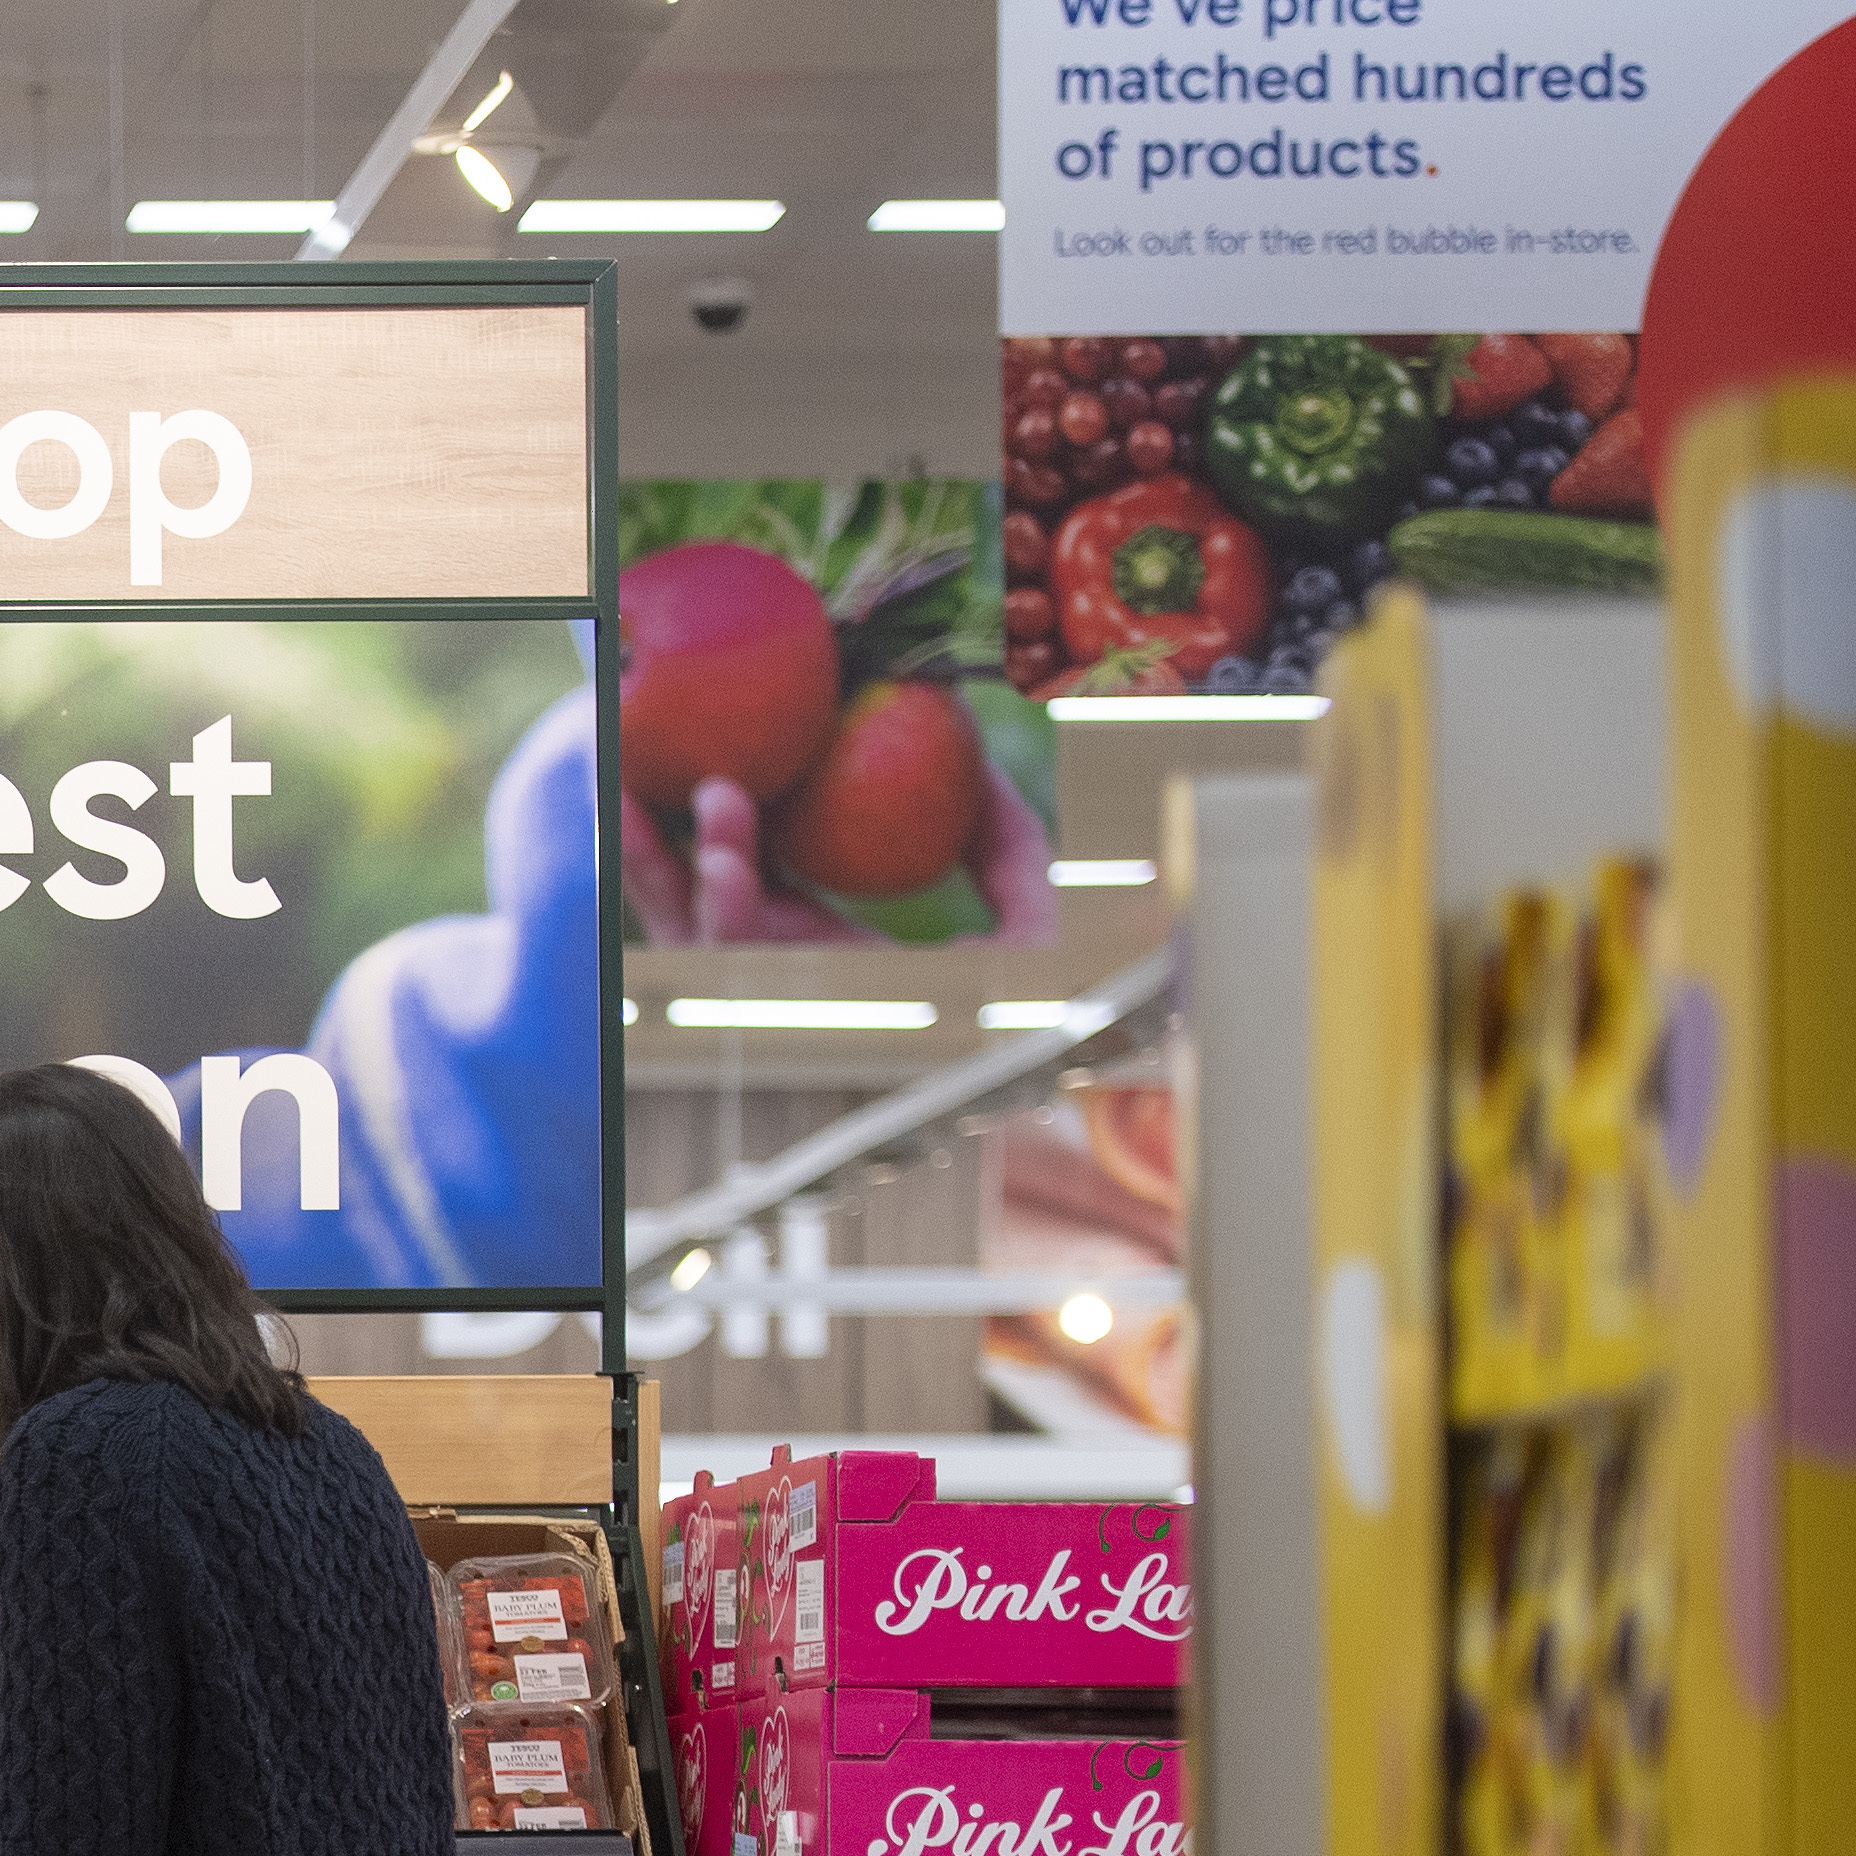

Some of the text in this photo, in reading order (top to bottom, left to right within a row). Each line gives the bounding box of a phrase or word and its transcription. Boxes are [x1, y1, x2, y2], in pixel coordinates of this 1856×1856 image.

[1060, 0, 1423, 40] Weve price
[1057, 50, 1648, 103] matched hundreds
[1055, 126, 1440, 191] of products.
[1054, 224, 1641, 259] Look out for the red bubble in-store.
[494, 1602, 558, 1612] BABY PLUM
[509, 1594, 539, 1602] TESCO
[874, 1546, 1081, 1636] Pink
[494, 1754, 559, 1763] BABY PLUM
[510, 1744, 541, 1753] TESCO
